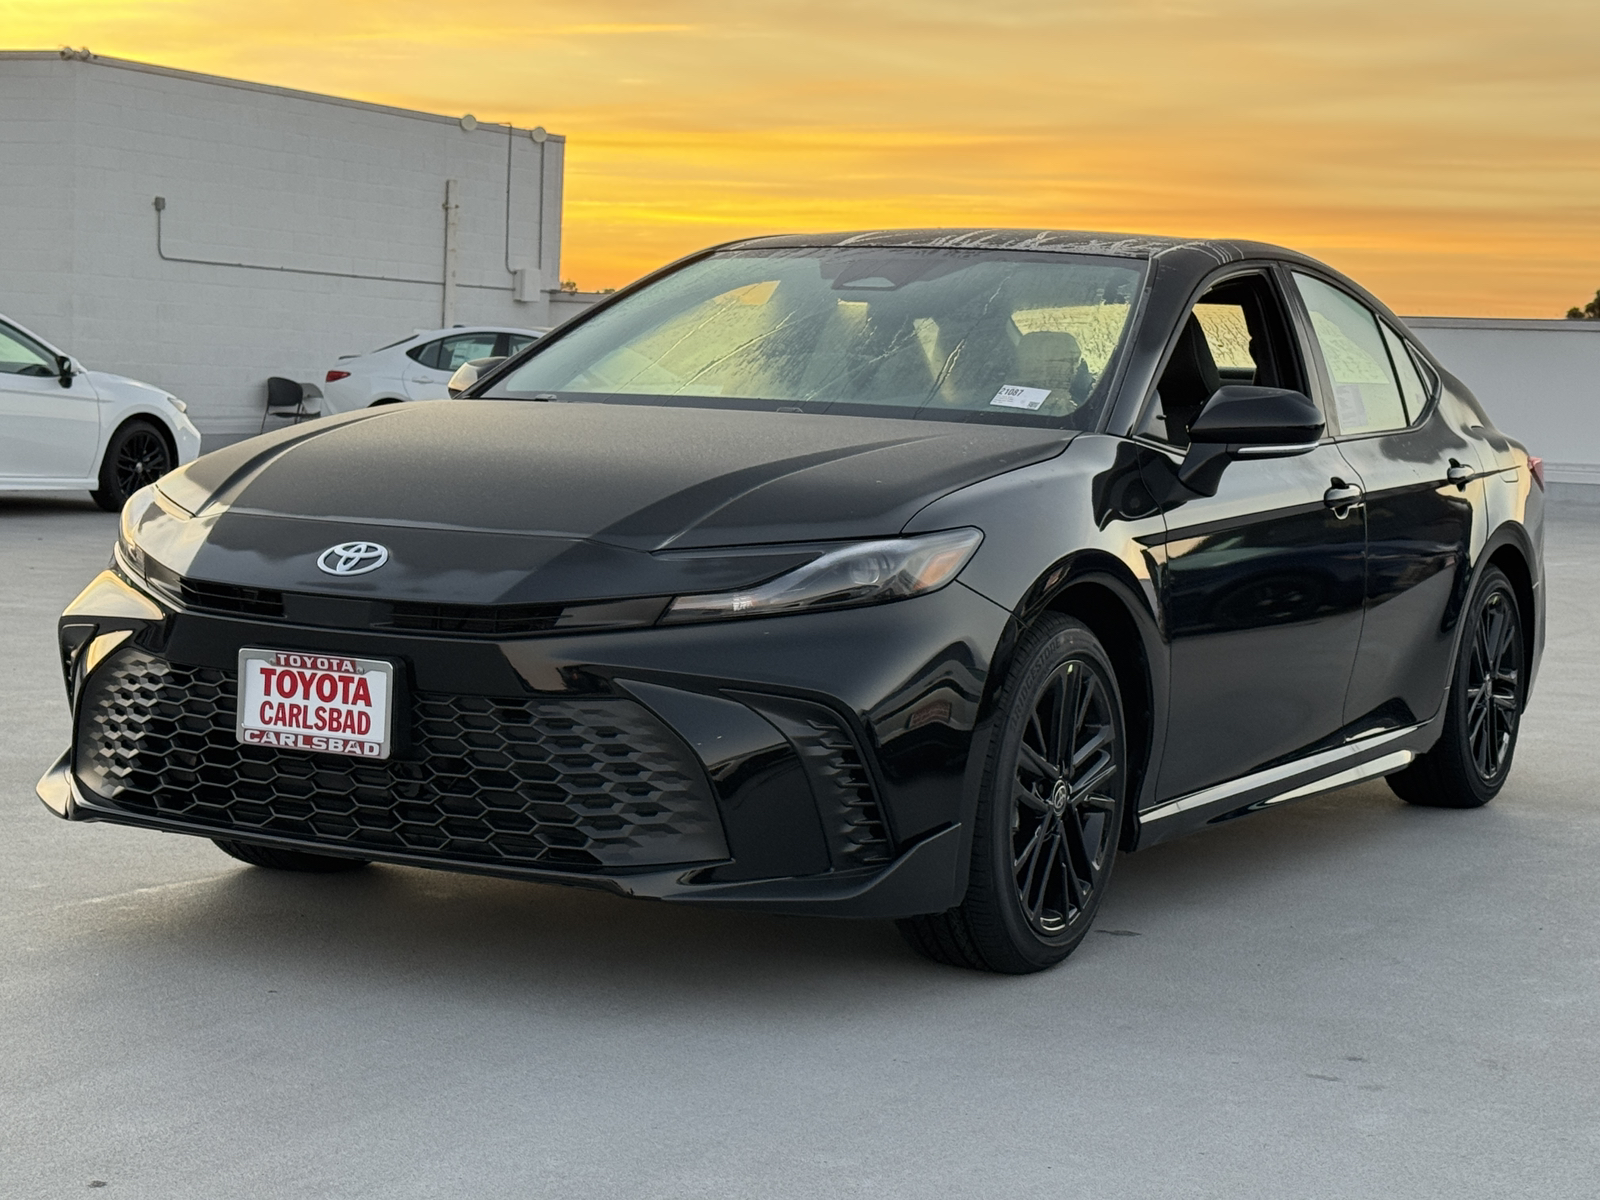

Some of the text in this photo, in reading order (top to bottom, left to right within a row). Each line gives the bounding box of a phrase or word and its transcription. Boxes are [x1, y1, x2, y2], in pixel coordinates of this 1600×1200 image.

[277, 654, 354, 673] TOYOTA
[260, 667, 372, 707] TOYOTA
[260, 700, 371, 735] CARLSBAD
[244, 729, 380, 756] CARLSBAD
